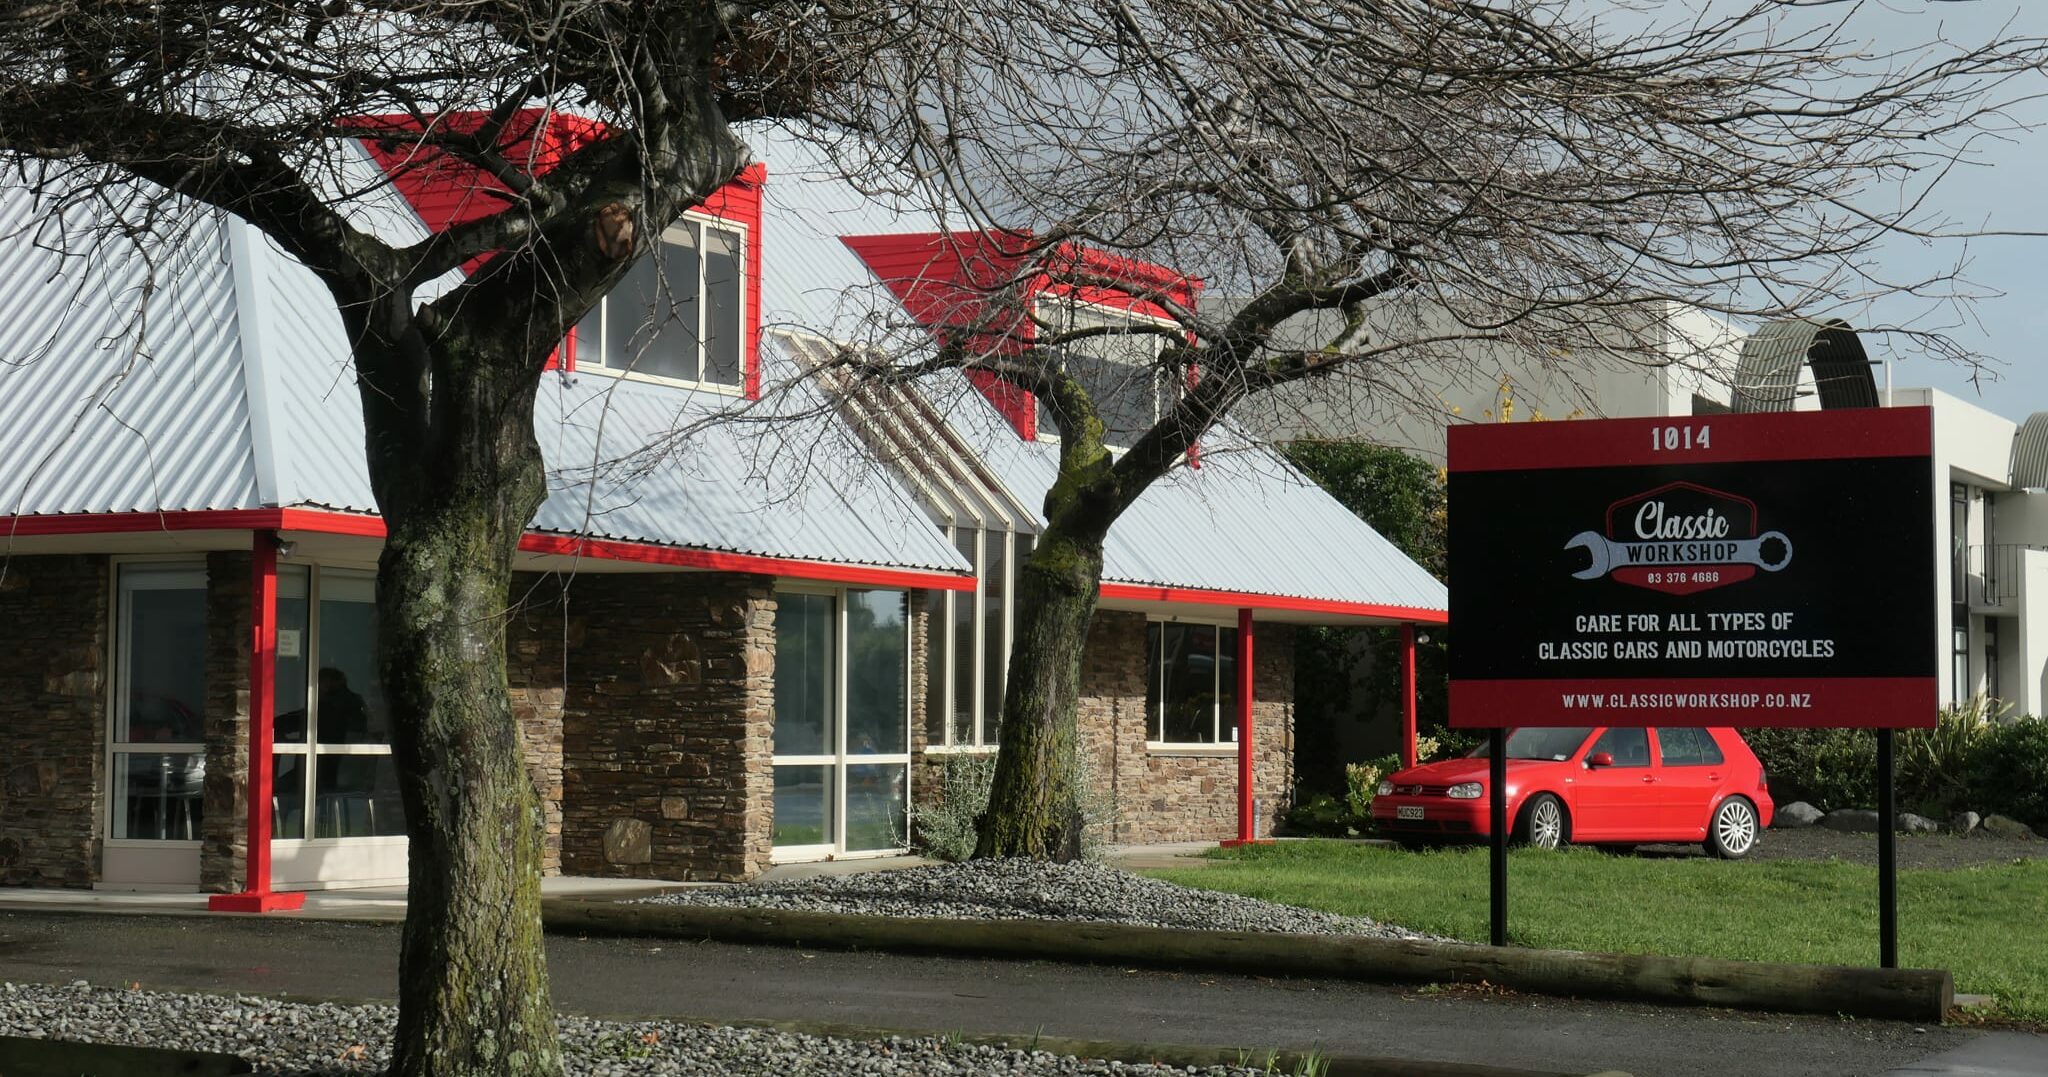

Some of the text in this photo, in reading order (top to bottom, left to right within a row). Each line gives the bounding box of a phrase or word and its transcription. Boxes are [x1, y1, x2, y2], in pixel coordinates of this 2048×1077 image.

[1652, 425, 1710, 451] 1014
[1634, 500, 1730, 539] Classic
[1626, 543, 1738, 563] WORKSHOP
[1647, 572, 1662, 584] 03
[1666, 572, 1687, 583] 376
[1576, 612, 1794, 633] CARE FOR ALL TYPES OF
[1538, 639, 1835, 660] CLASSIC CARS AND MOTORCYCLES
[1562, 692, 1812, 709] WWW.CLASSICWORKSHOP.CO.NZ
